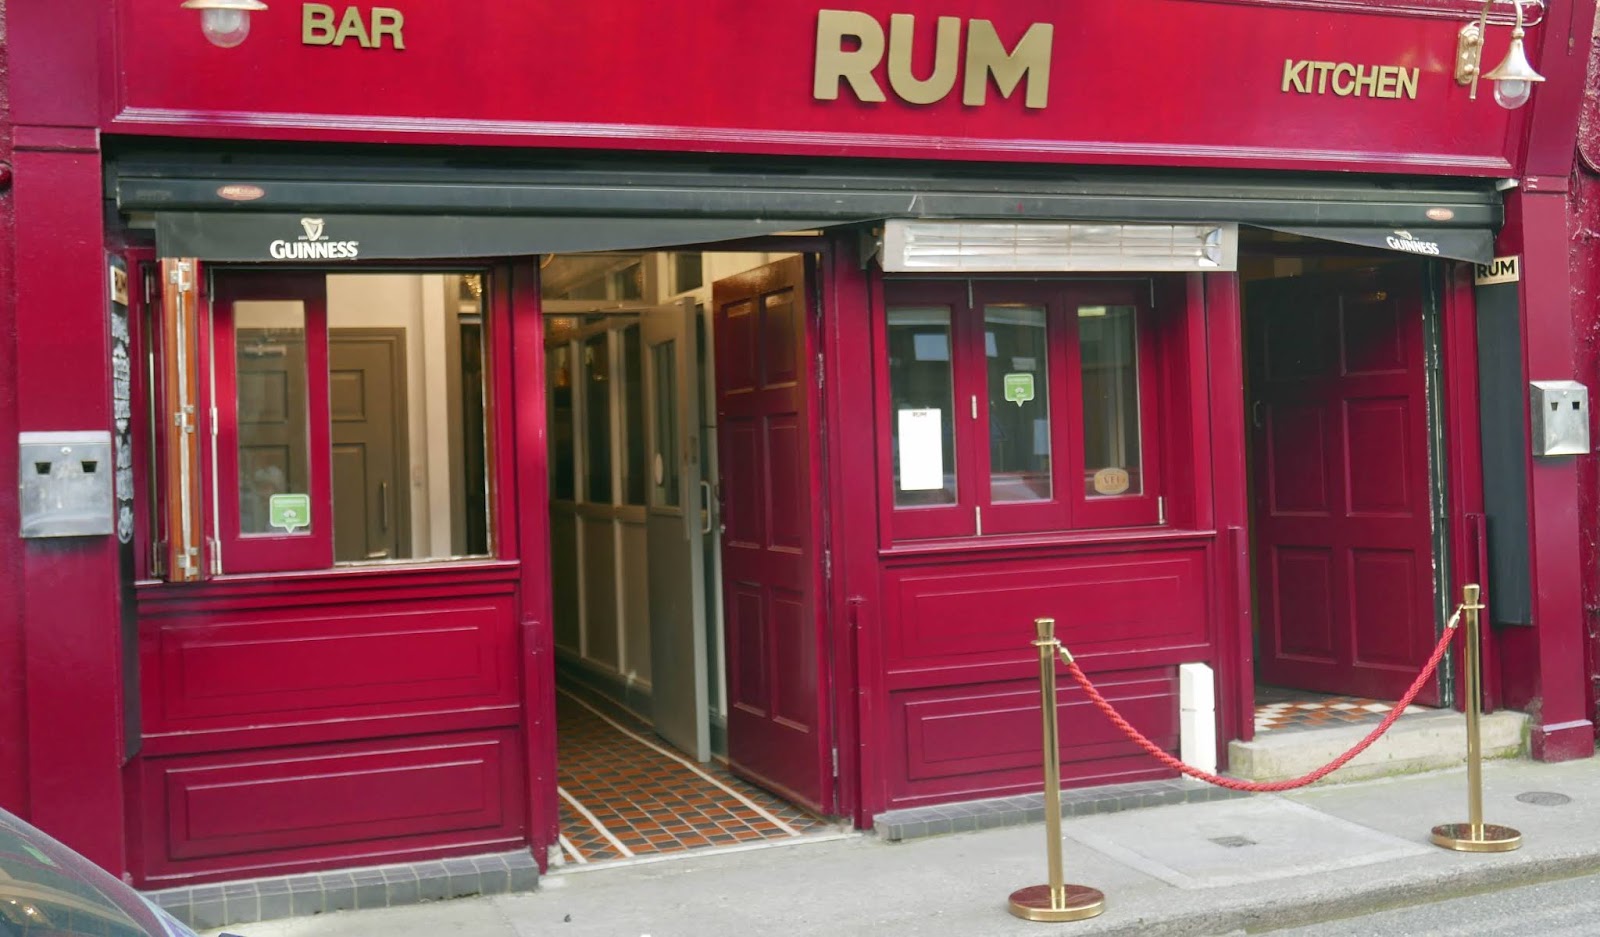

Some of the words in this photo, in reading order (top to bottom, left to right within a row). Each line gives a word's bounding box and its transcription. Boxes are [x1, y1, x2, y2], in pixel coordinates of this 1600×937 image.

[302, 3, 406, 50] BAR
[813, 9, 1054, 109] RUM
[1281, 59, 1420, 100] KITCHEN
[270, 240, 358, 259] GUINNESS
[1386, 236, 1440, 255] GUINNESS
[1477, 259, 1515, 279] RUM
